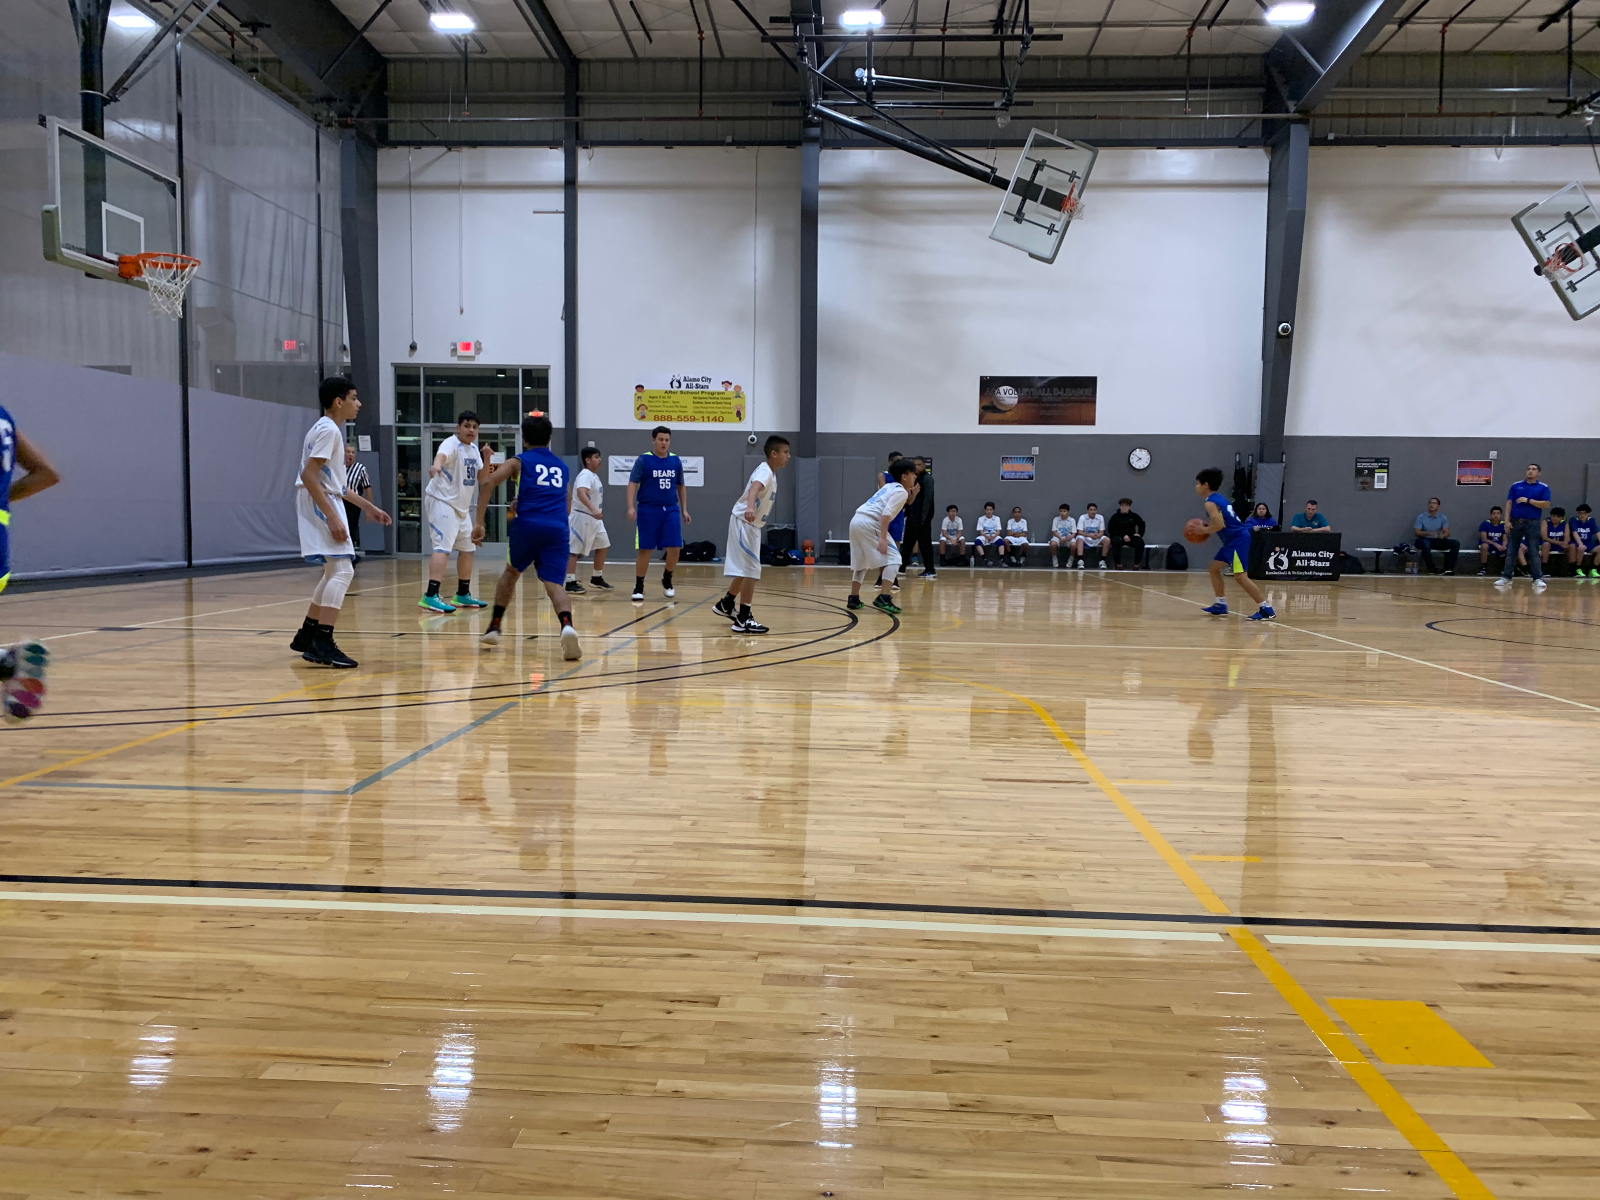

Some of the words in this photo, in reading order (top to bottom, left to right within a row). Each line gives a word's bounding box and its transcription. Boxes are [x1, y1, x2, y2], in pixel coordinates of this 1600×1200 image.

[701, 376, 712, 384] City
[535, 463, 563, 488] 23
[652, 470, 676, 478] BEARS
[659, 479, 671, 490] 55
[1318, 550, 1335, 559] City
[1295, 559, 1330, 567] All-Stars
